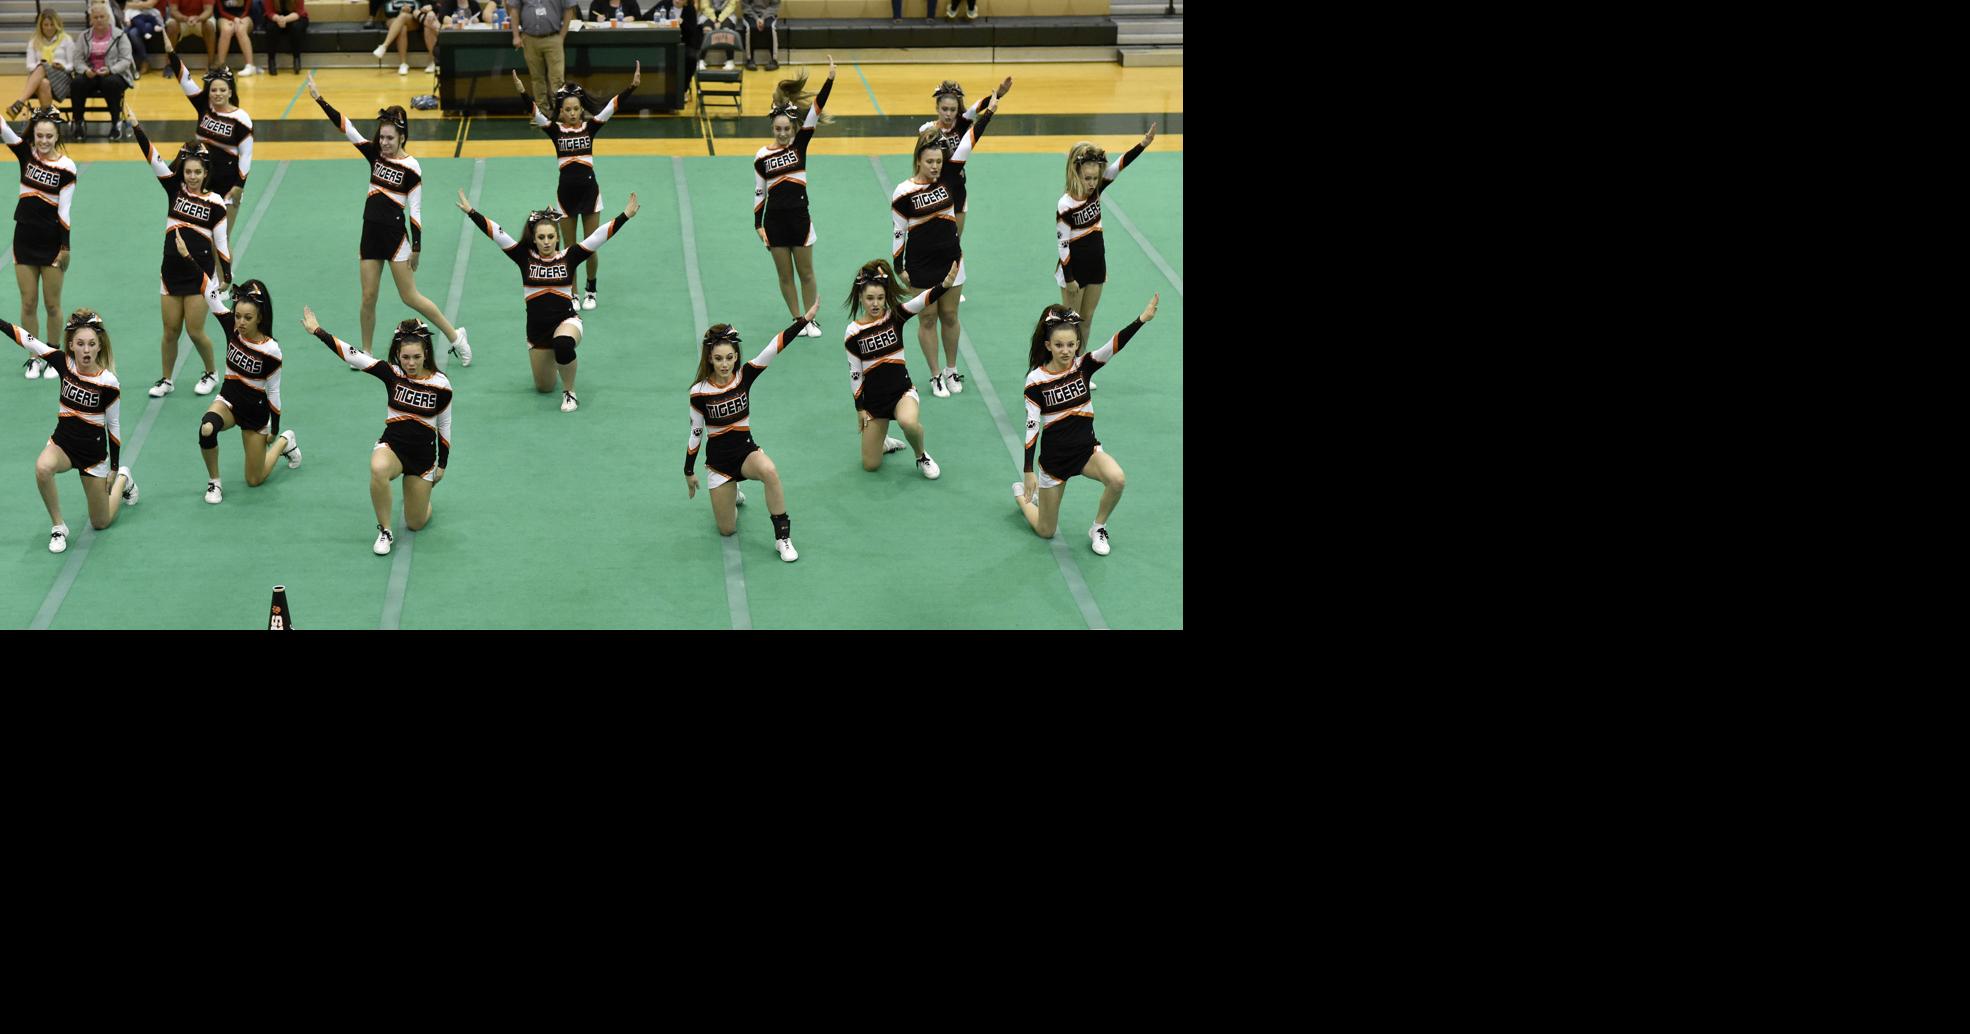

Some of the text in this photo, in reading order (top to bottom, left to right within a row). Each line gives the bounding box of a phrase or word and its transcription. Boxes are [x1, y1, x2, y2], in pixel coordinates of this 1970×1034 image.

[200, 116, 232, 136] TIGERS
[558, 137, 590, 151] TIGERS
[26, 164, 59, 187] TIGERS
[374, 163, 403, 185] TIGERS
[174, 197, 210, 220] TIGERS
[911, 187, 948, 210] TIGERS
[529, 265, 567, 278] TIGERS
[858, 329, 896, 353] TIGERS
[227, 343, 262, 373] TIGERS
[61, 379, 99, 407] TIGERS
[394, 384, 437, 409] TIGERS
[1042, 378, 1086, 406] TIGERS
[707, 392, 748, 418] TIGERS
